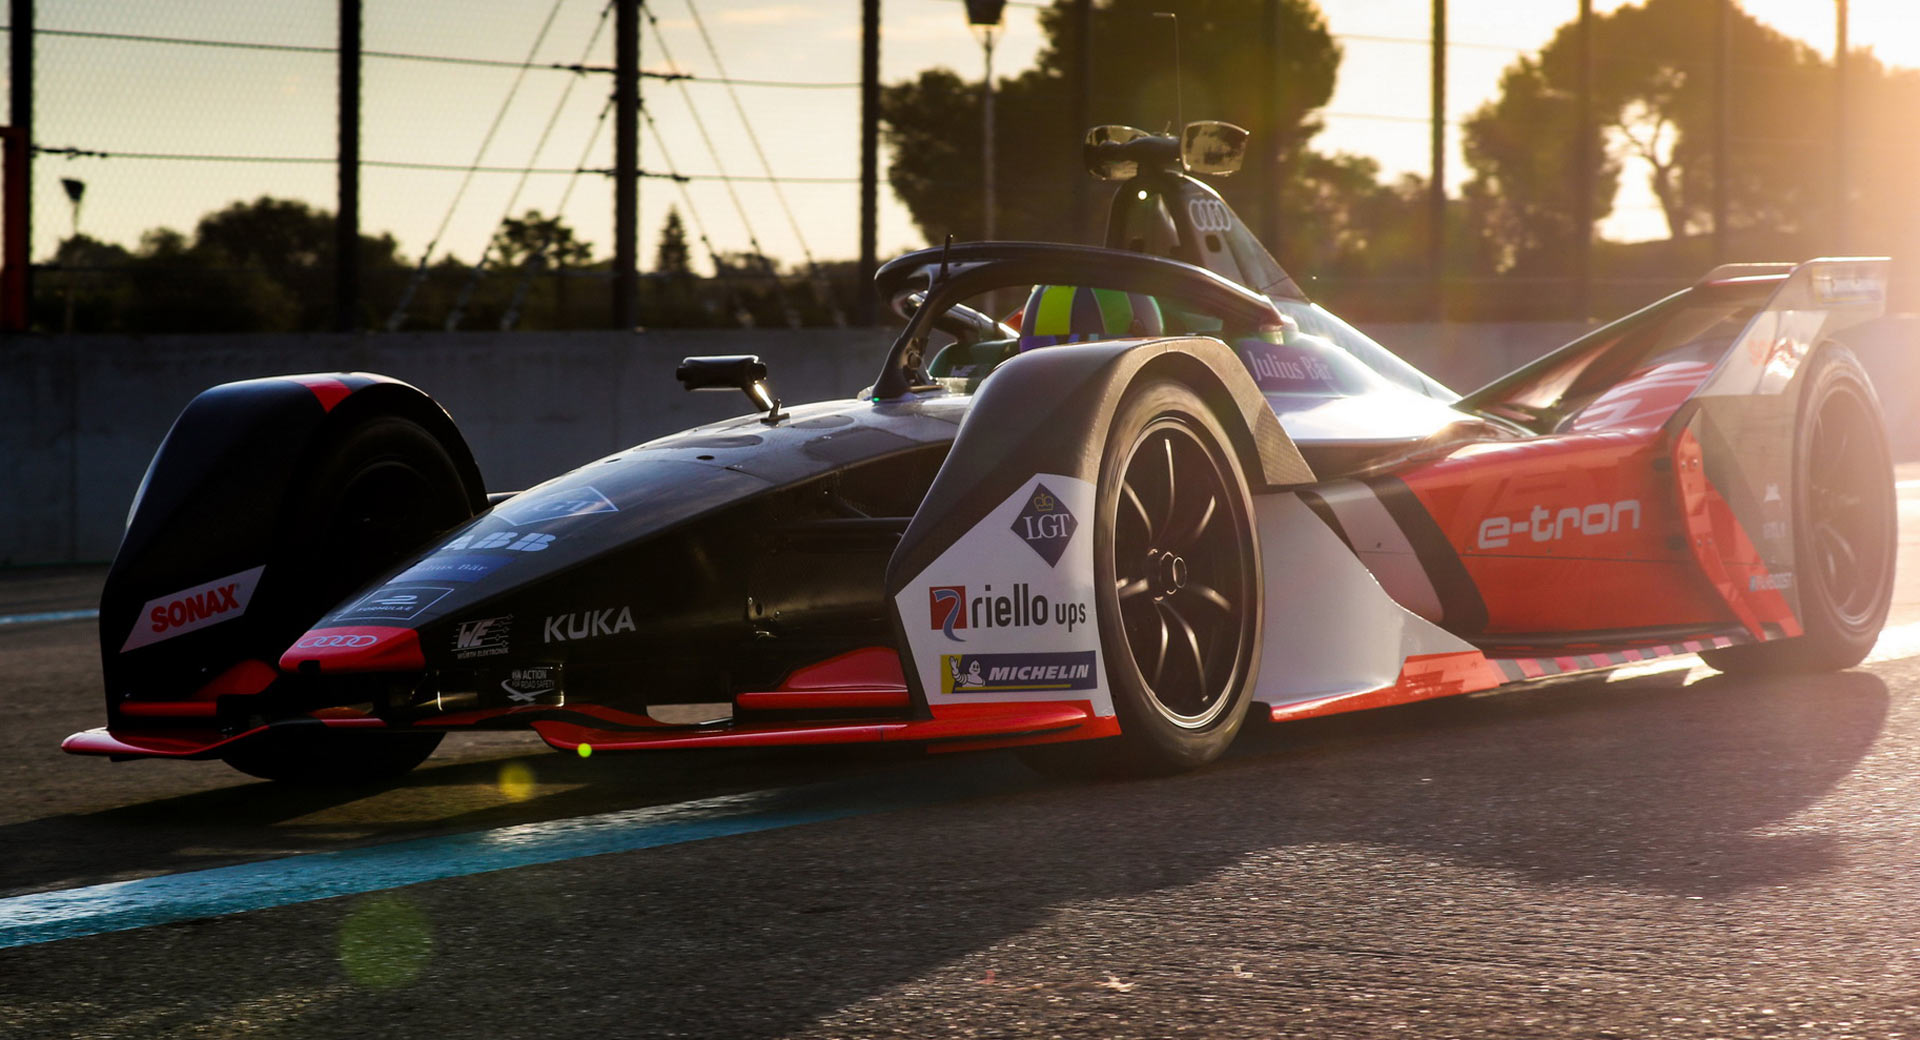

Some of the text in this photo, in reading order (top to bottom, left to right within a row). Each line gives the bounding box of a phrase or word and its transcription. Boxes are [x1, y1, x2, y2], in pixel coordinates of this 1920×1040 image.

[1247, 350, 1305, 381] Julius
[1023, 513, 1070, 540] LGT
[1478, 500, 1641, 549] e-tron
[441, 532, 556, 551] ABB
[150, 583, 239, 633] SONAX
[972, 583, 1087, 632] riello ups
[544, 606, 637, 643] KUKA
[522, 669, 547, 680] ACTION
[988, 664, 1089, 681] MICHELIN
